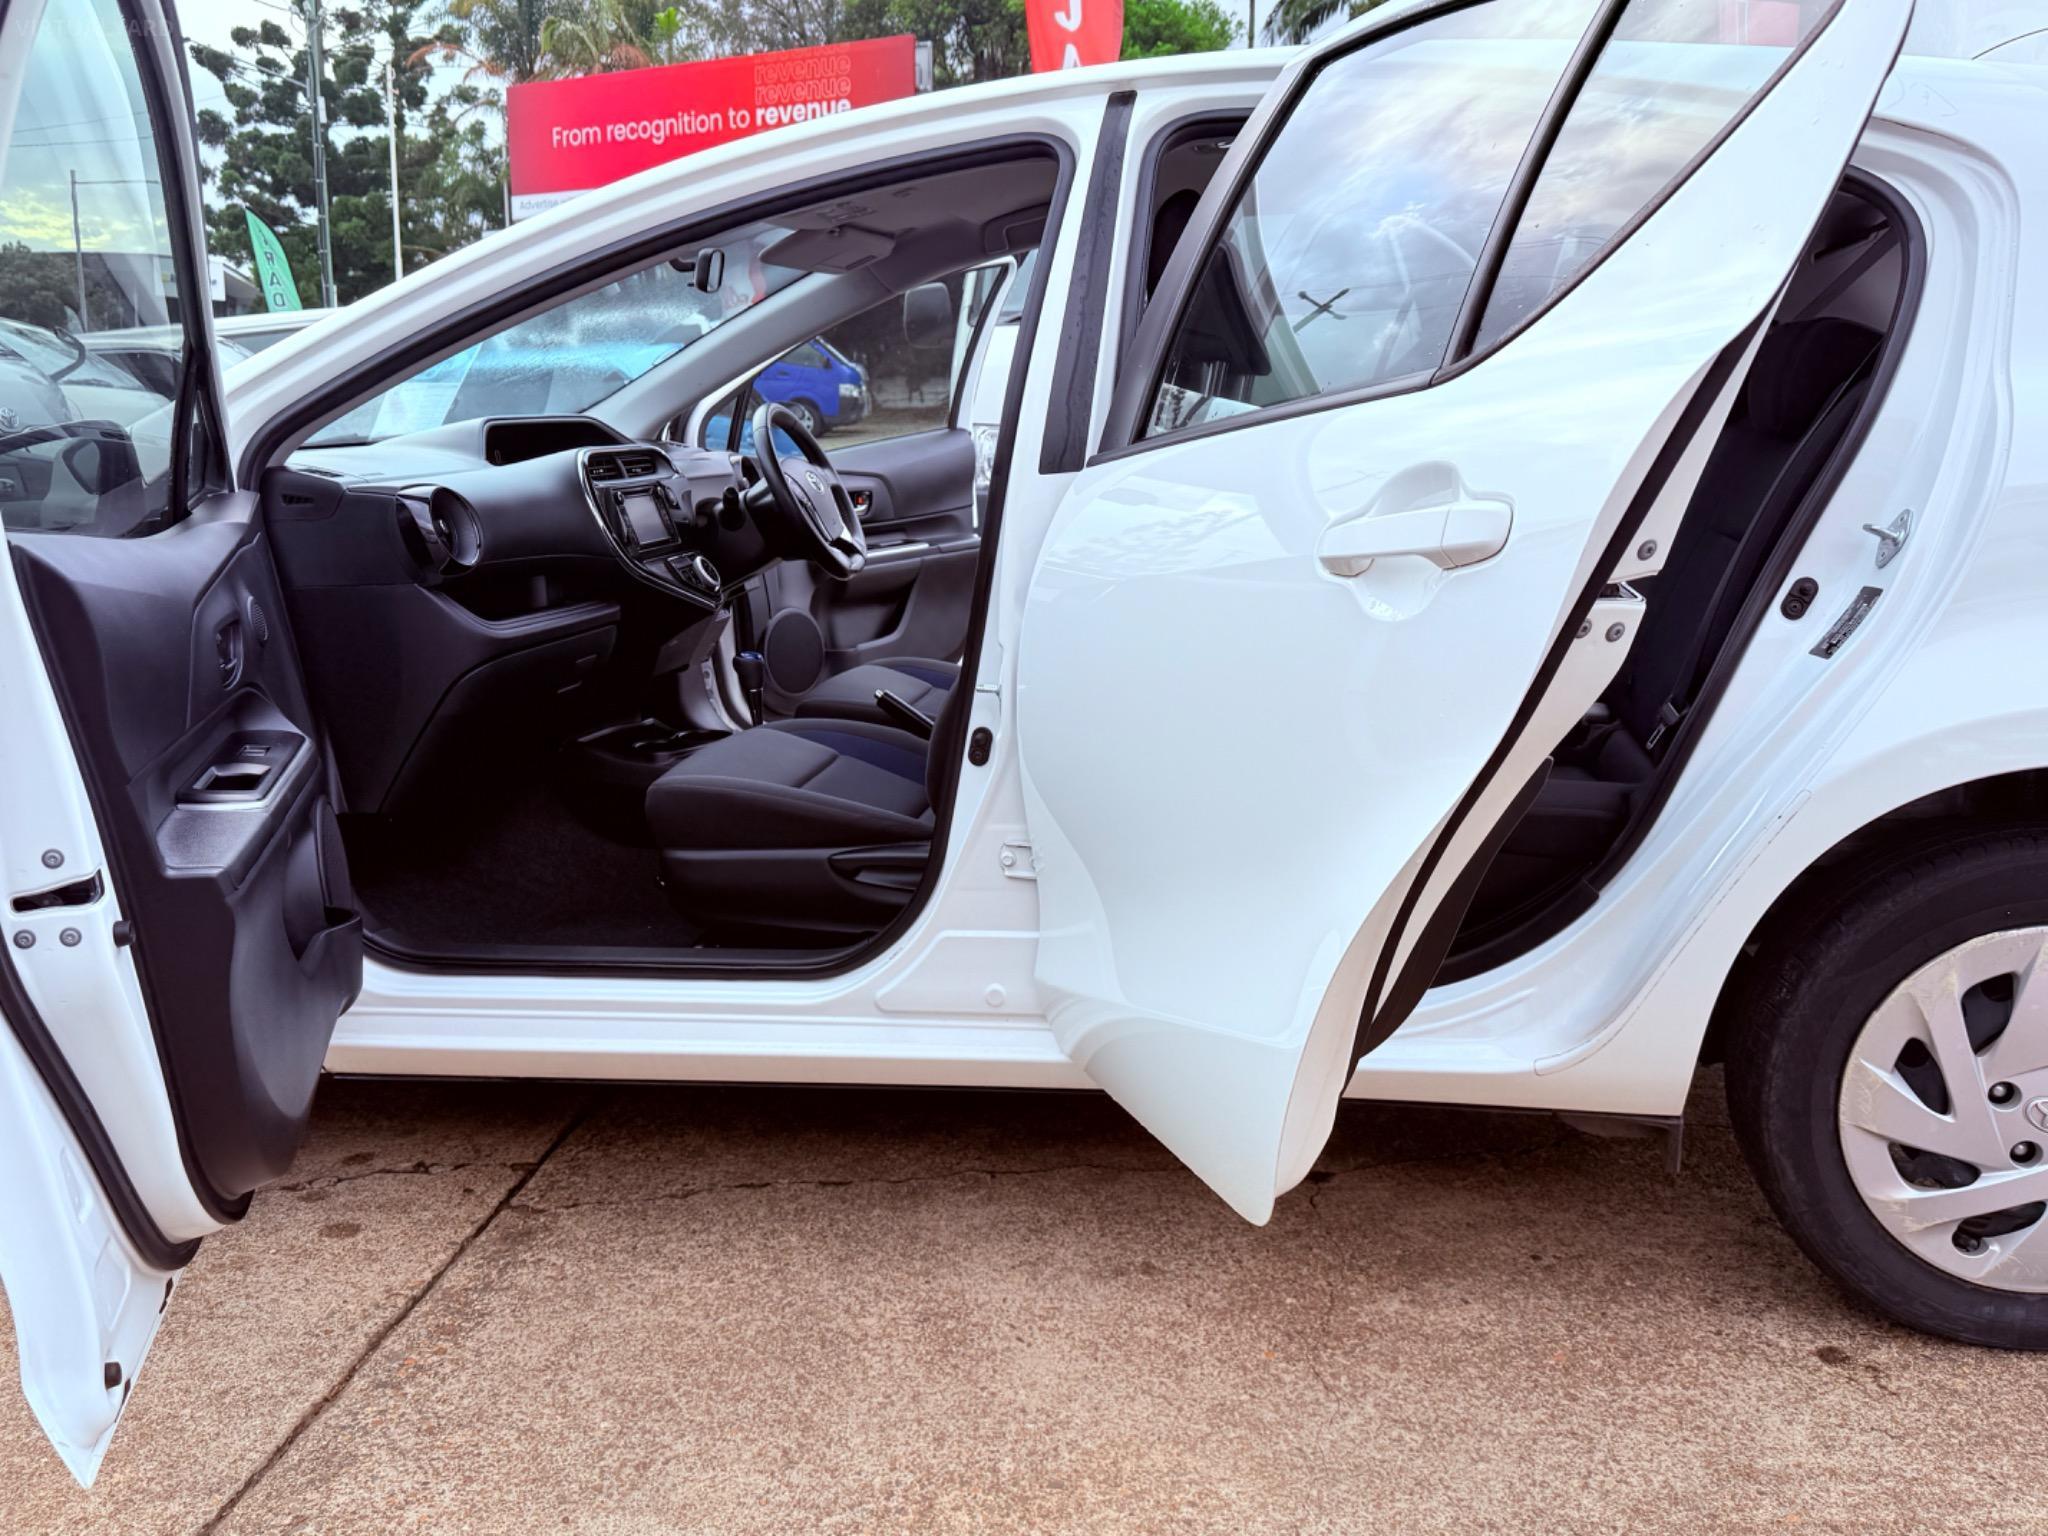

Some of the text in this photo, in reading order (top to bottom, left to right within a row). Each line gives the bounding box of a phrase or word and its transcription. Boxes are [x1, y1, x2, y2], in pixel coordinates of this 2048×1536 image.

[754, 55, 851, 85] revenue
[755, 76, 852, 106] revenue
[552, 98, 852, 149] From recognition to revenue
